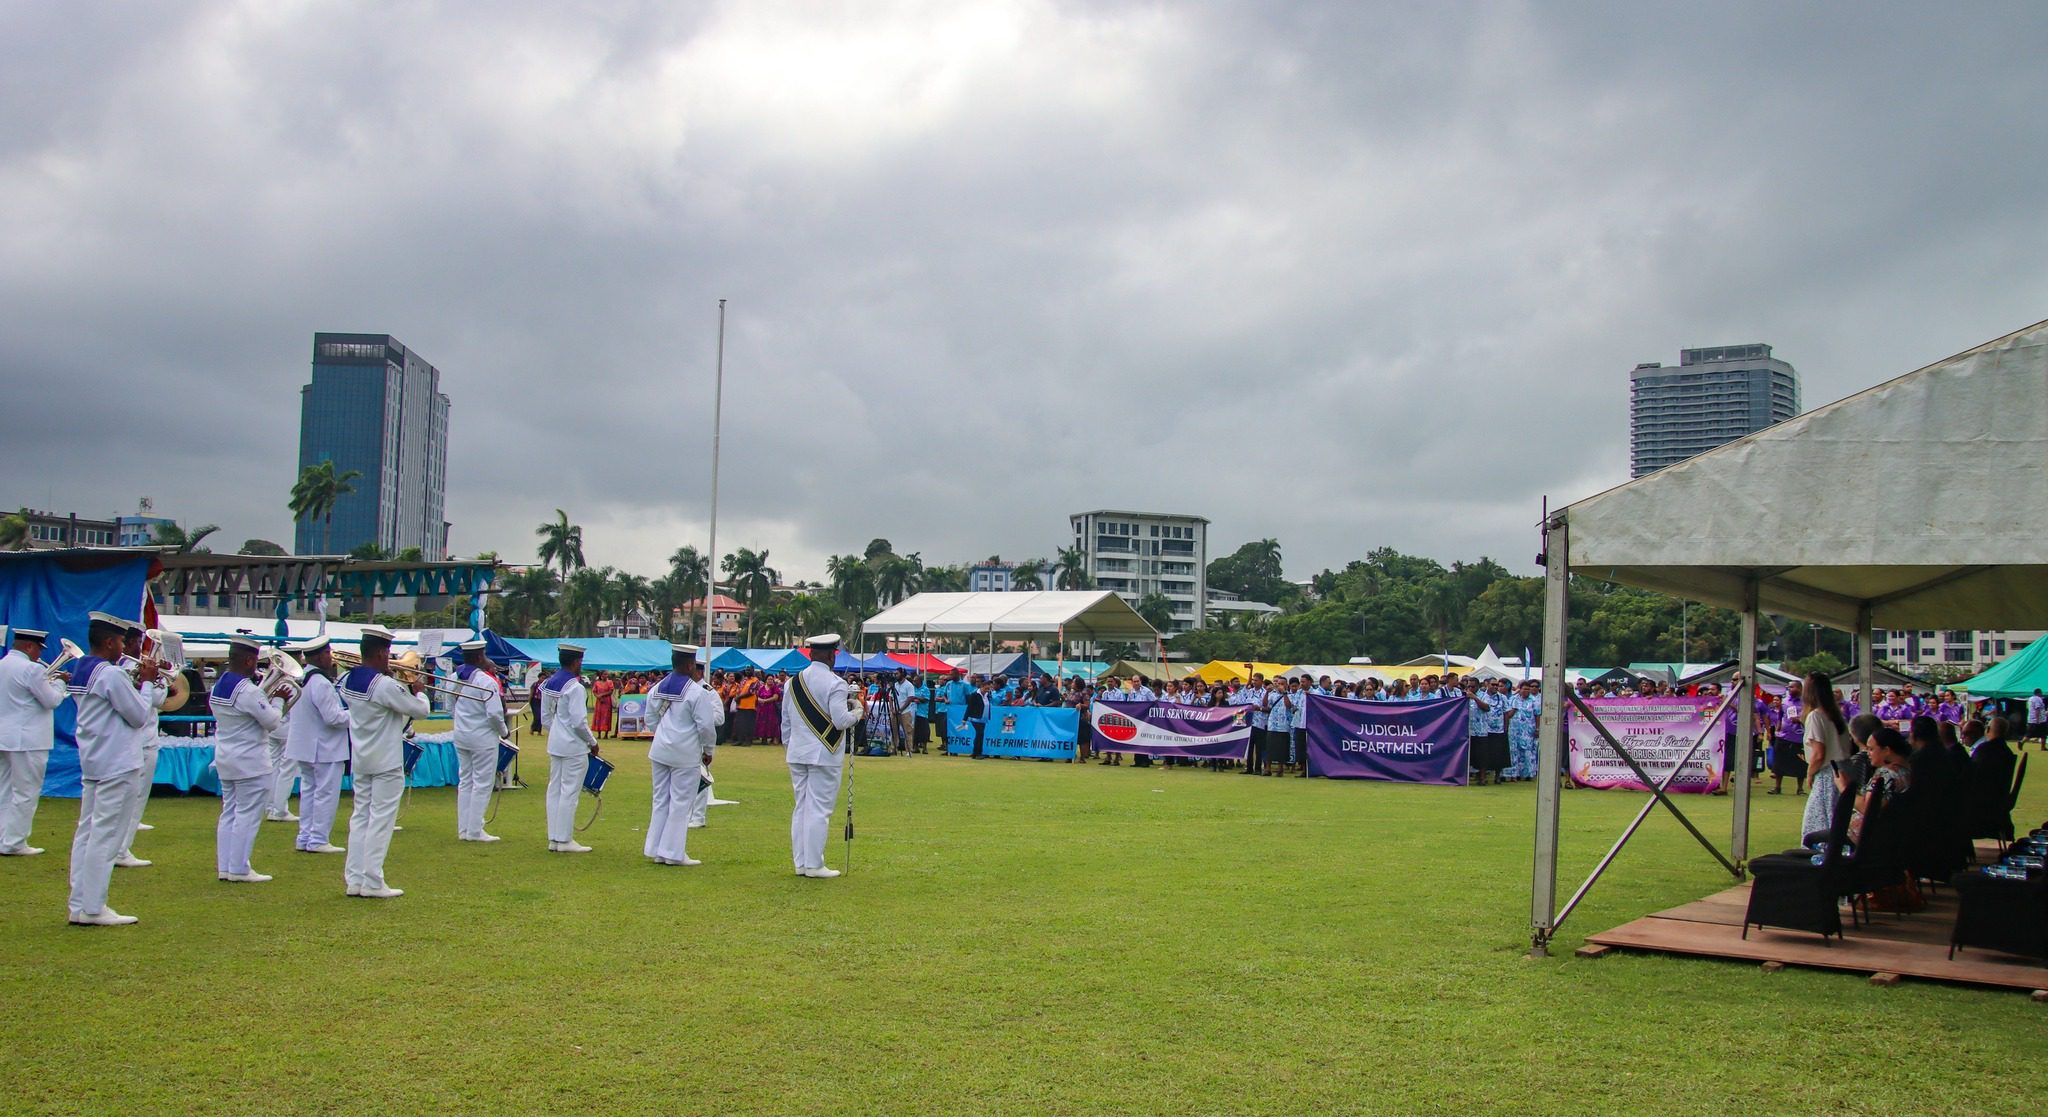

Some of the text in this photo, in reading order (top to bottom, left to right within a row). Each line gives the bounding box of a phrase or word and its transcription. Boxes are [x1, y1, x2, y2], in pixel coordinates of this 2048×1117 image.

[1148, 707, 1213, 721] CIVIL SERVICE DAY
[1356, 723, 1417, 737] JUDICIAL
[1625, 727, 1665, 735] THEME
[947, 735, 971, 747] OFFICE
[985, 737, 1001, 748] THE
[1003, 738, 1029, 749] PRIME
[1342, 739, 1435, 755] DEPARTMENT
[1584, 749, 1593, 759] IN
[1633, 749, 1657, 760] DRUGS
[1657, 749, 1673, 760] AND
